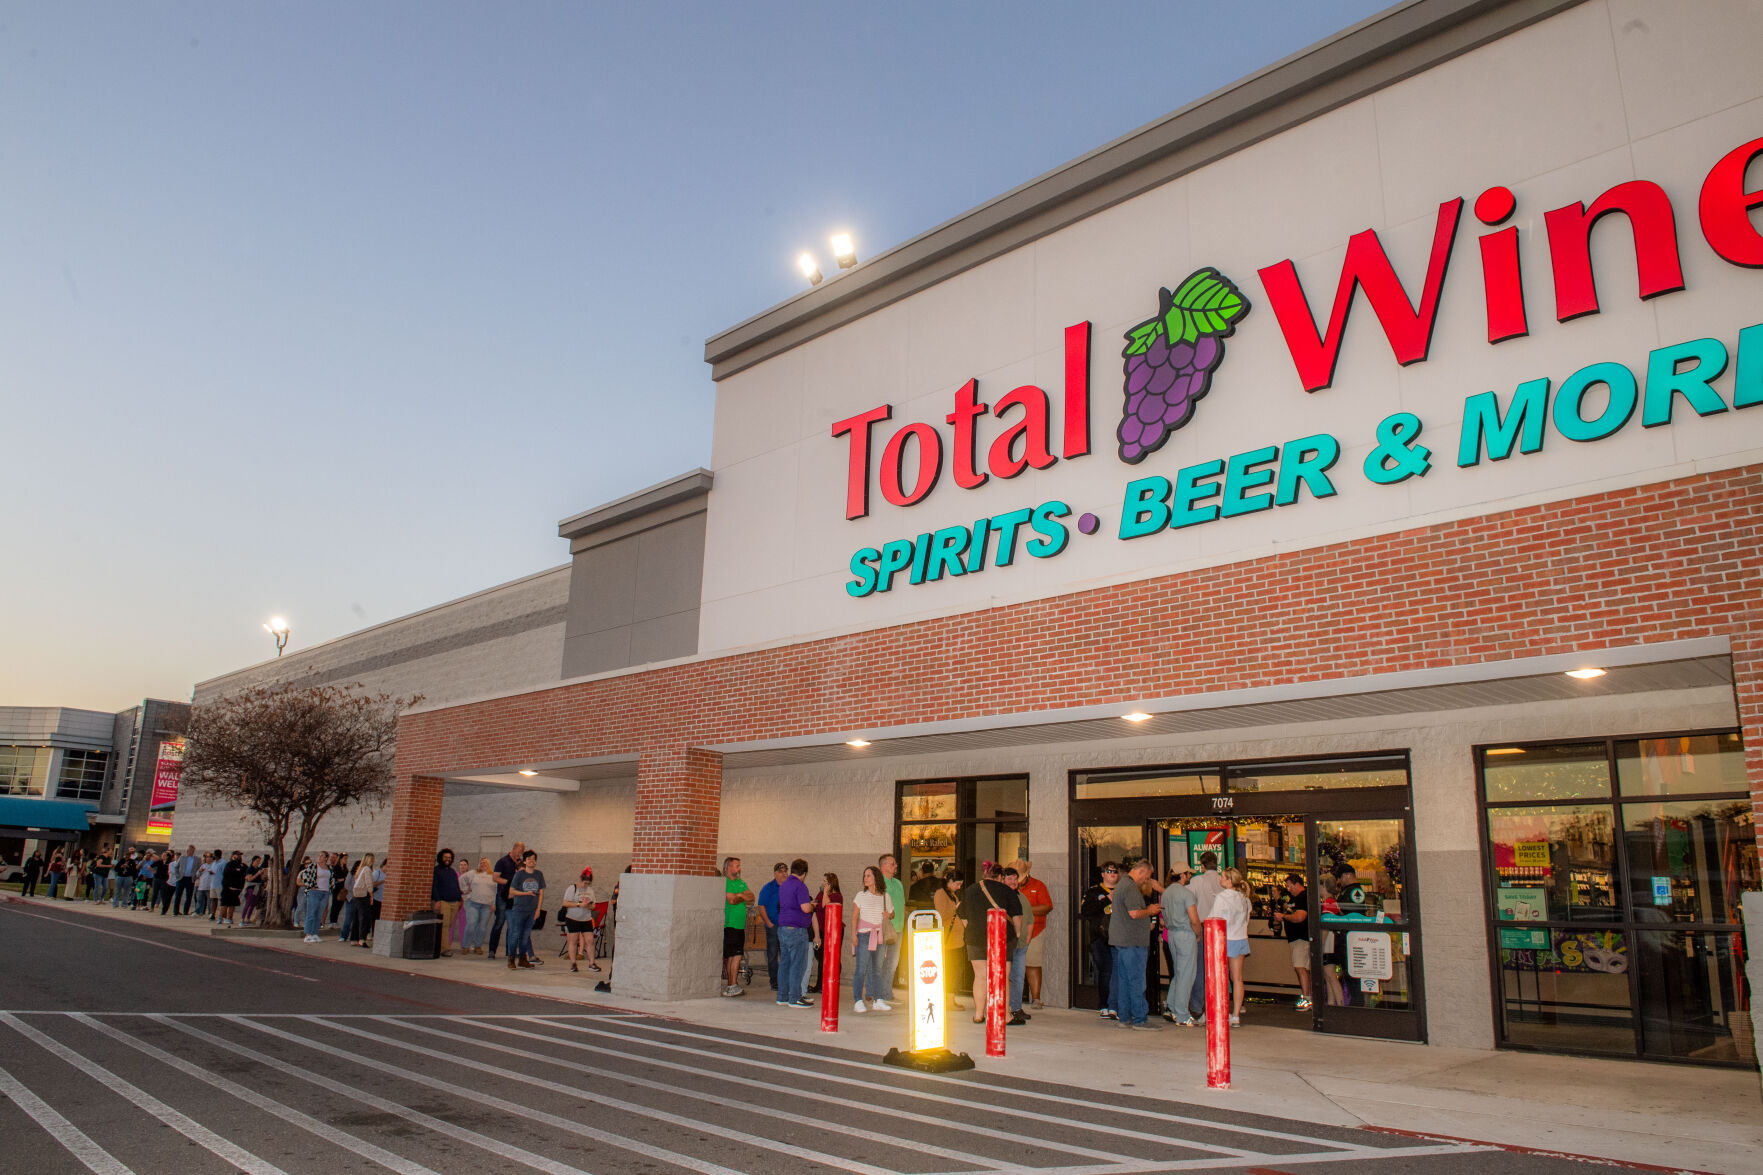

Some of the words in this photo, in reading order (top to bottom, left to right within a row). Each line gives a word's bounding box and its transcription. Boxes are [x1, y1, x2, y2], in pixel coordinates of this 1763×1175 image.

[832, 320, 1089, 520] Total
[1258, 137, 1763, 392] Wine
[846, 500, 1071, 598] SPIRITS
[1119, 434, 1340, 541] BEER
[1363, 412, 1432, 485] &
[1211, 797, 1234, 809] 7074
[1193, 843, 1222, 851] ALWAYS
[920, 966, 937, 978] STOP
